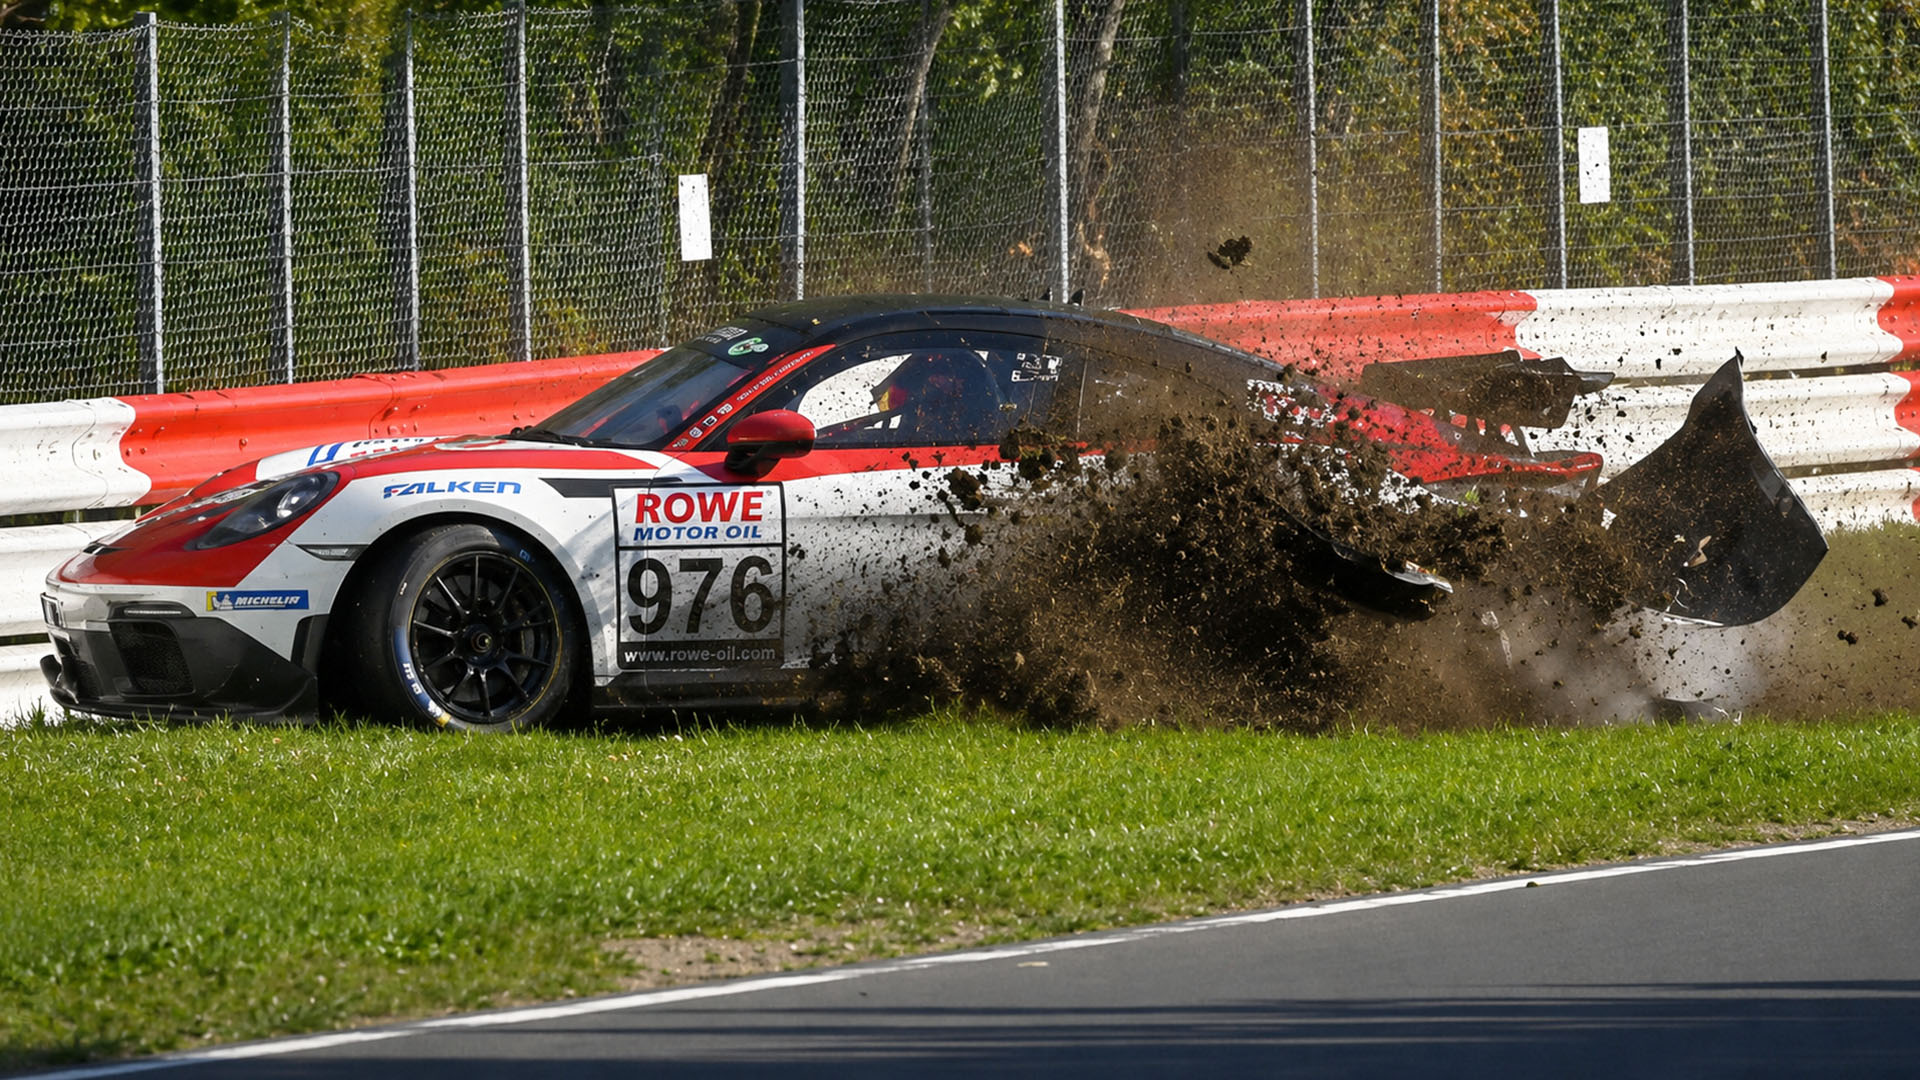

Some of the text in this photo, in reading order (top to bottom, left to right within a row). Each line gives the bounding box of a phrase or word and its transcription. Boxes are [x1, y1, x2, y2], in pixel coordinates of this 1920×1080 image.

[383, 481, 522, 499] FALKEN
[635, 491, 764, 524] ROWE
[633, 525, 762, 541] MOTOR OIL
[235, 595, 301, 606] MICHELIN
[627, 555, 775, 635] 976
[624, 645, 776, 663] www.rowe-oil.com
